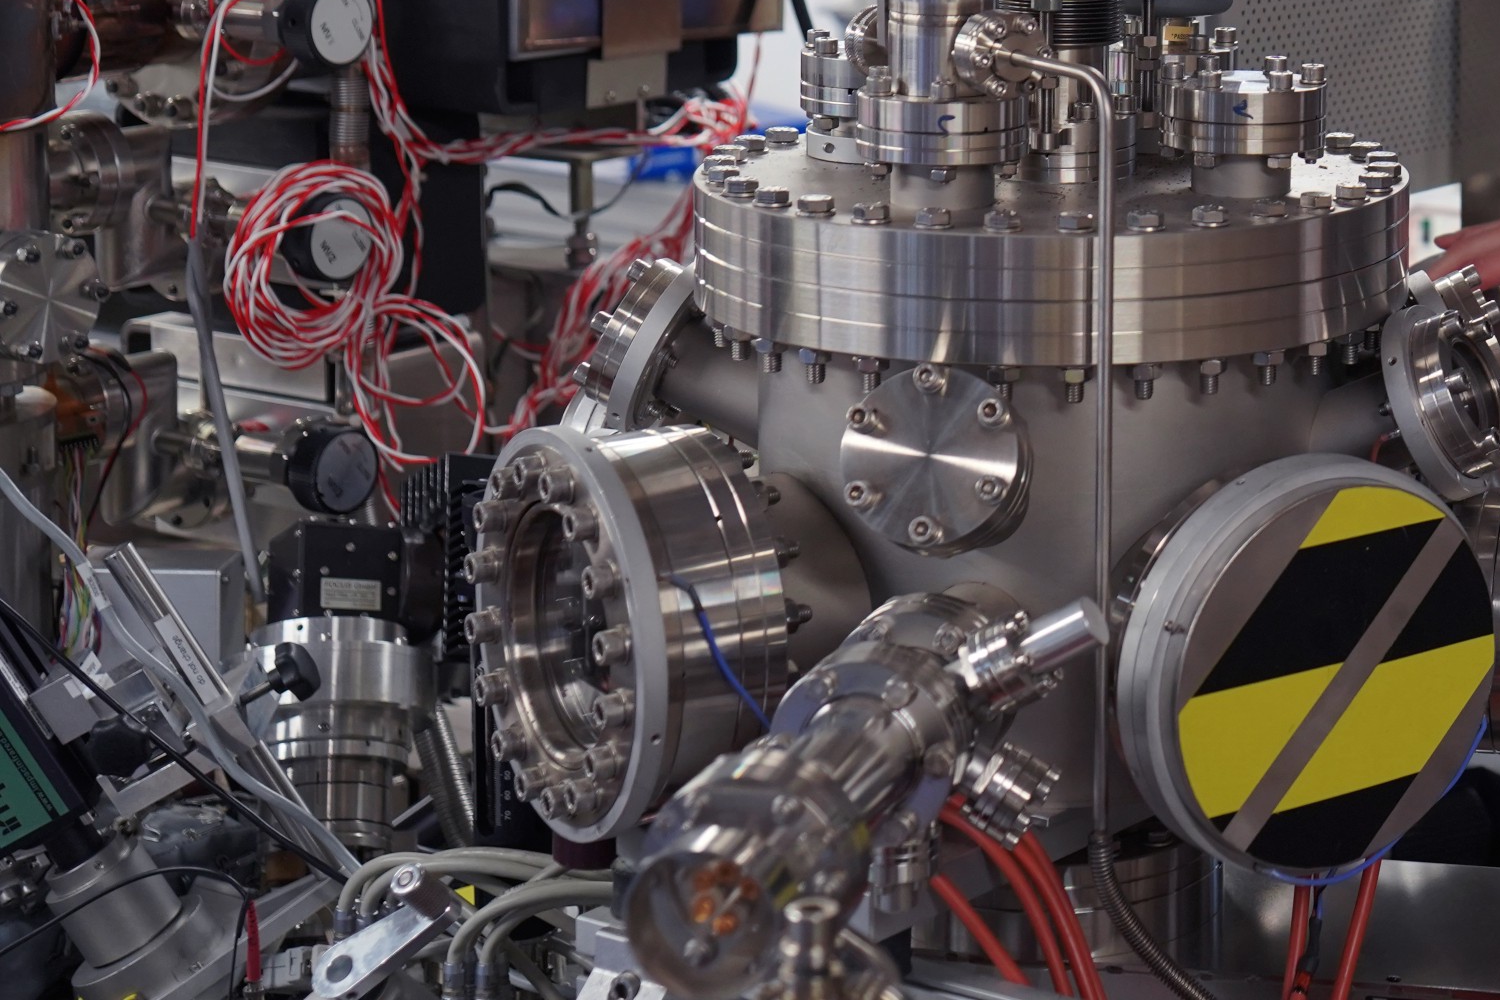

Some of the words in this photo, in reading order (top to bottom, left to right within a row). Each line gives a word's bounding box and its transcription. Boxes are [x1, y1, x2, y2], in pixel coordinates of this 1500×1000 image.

[172, 635, 191, 661] change
[188, 661, 199, 675] not
[196, 674, 206, 685] do
[503, 790, 512, 801] 60
[503, 810, 512, 821] 70
